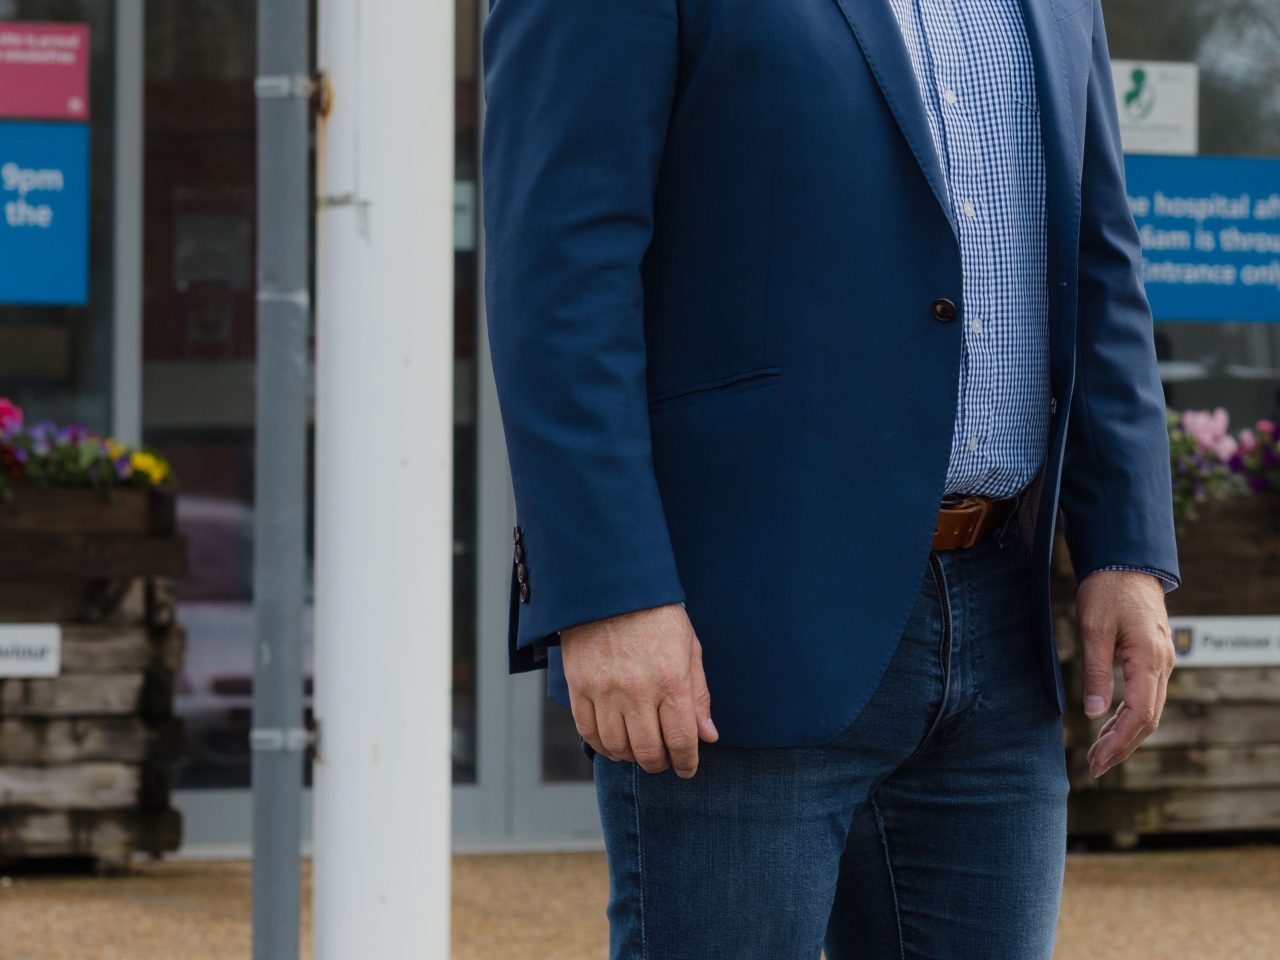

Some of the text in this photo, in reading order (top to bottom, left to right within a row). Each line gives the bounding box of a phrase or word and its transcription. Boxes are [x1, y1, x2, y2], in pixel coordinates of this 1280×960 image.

[2, 162, 64, 195] 9pm
[5, 198, 53, 227] the
[1154, 191, 1250, 223] hospital
[1141, 224, 1191, 250] 6am
[1194, 226, 1216, 252] is
